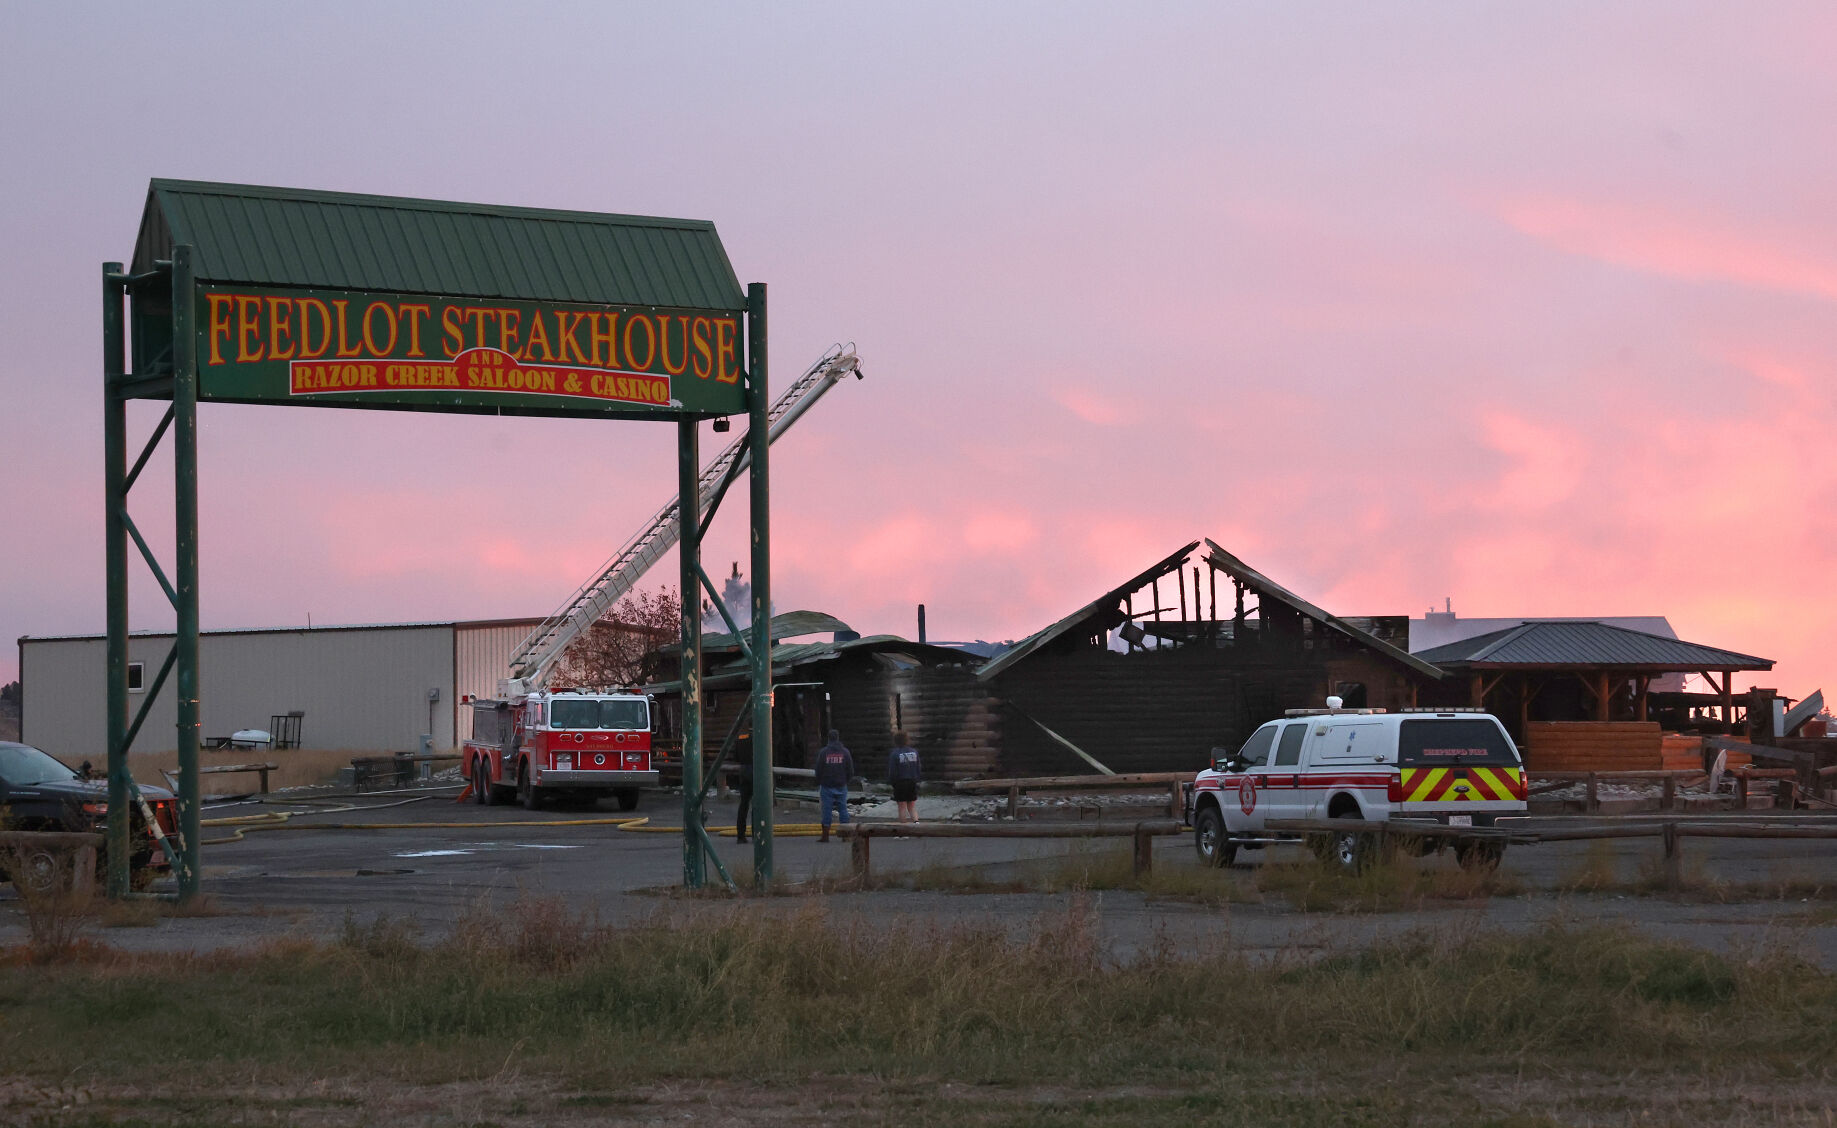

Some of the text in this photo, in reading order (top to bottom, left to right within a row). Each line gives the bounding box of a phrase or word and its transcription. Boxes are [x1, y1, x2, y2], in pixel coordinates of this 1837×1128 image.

[205, 293, 740, 385] FEEDLOT STEAKHOUSE
[470, 351, 503, 366] AND
[294, 364, 668, 403] RAZOR CREEK SALOON & CASINO
